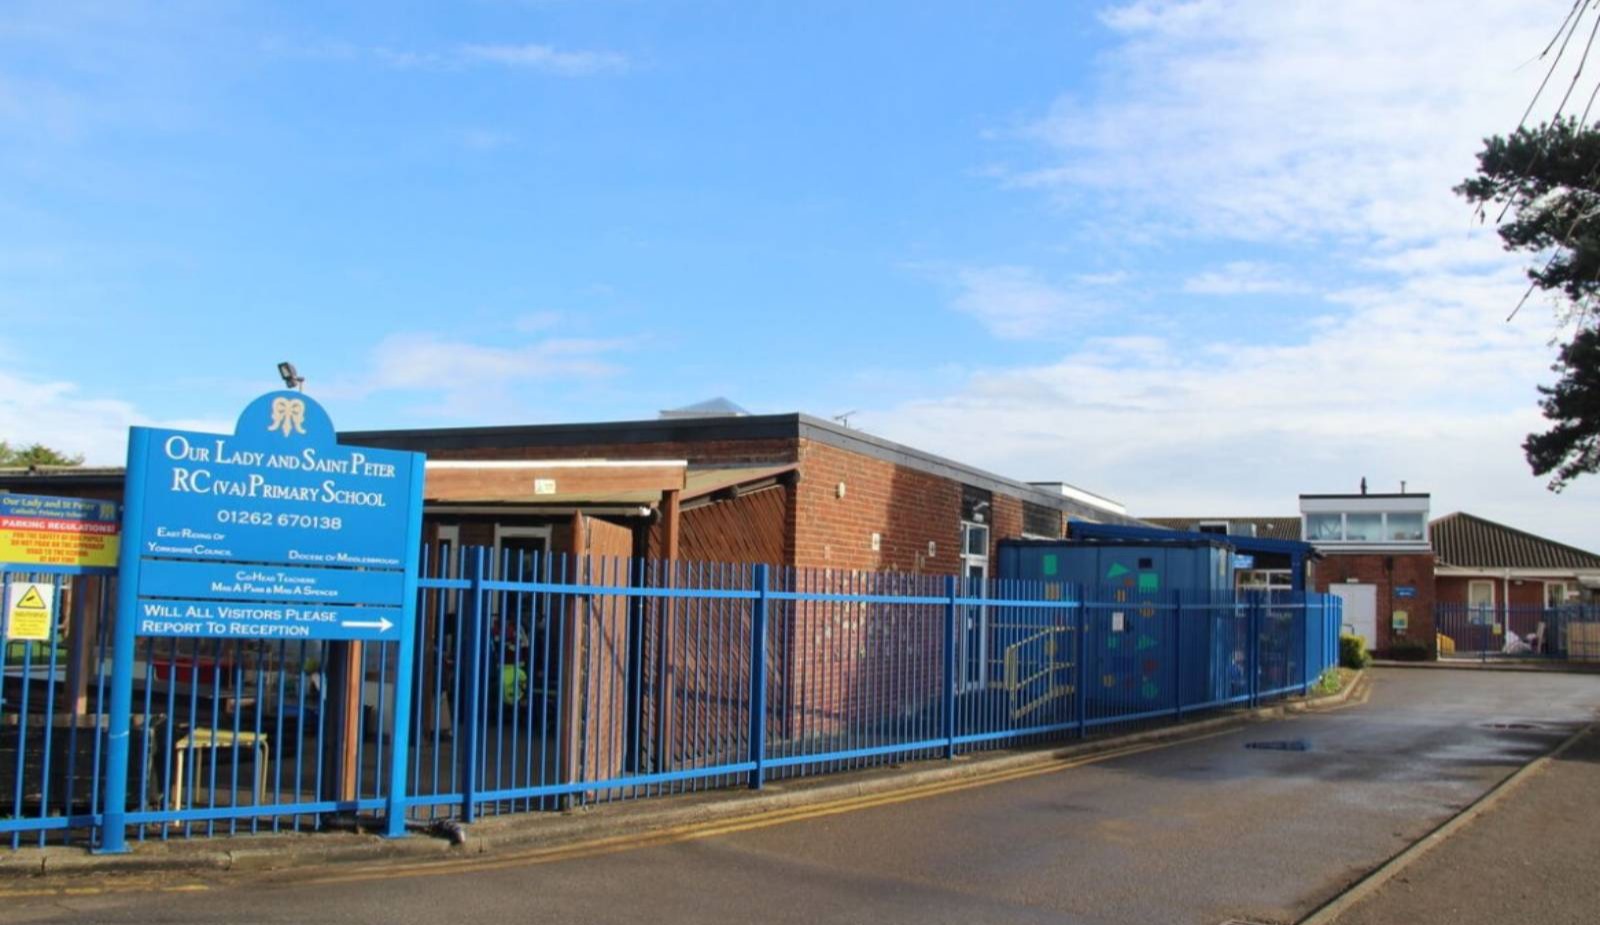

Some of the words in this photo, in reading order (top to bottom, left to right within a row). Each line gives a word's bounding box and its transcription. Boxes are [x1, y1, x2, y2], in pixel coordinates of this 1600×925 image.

[165, 436, 210, 462] OUR
[216, 440, 264, 466] LADY
[267, 457, 300, 469] AND
[302, 448, 348, 474] SAINT
[351, 453, 396, 477] PETER
[170, 468, 210, 493] RC
[213, 480, 246, 497] (VA)
[249, 474, 320, 502] PRIMARY
[322, 480, 386, 507] SCHOOL
[22, 498, 41, 508] Lady
[44, 500, 61, 508] and
[2, 520, 45, 528] PARKING
[218, 510, 272, 526] 01262
[278, 516, 342, 530] 670138
[194, 544, 232, 556] COUNCIL
[233, 583, 242, 592] A
[294, 586, 302, 594] A
[144, 604, 181, 618] WILL
[186, 606, 214, 618] ALL
[218, 607, 282, 620] VISITORS
[286, 608, 336, 622] PLEASE
[142, 620, 202, 633] REPORT
[206, 622, 226, 634] TO
[230, 622, 309, 636] RECEPTION
